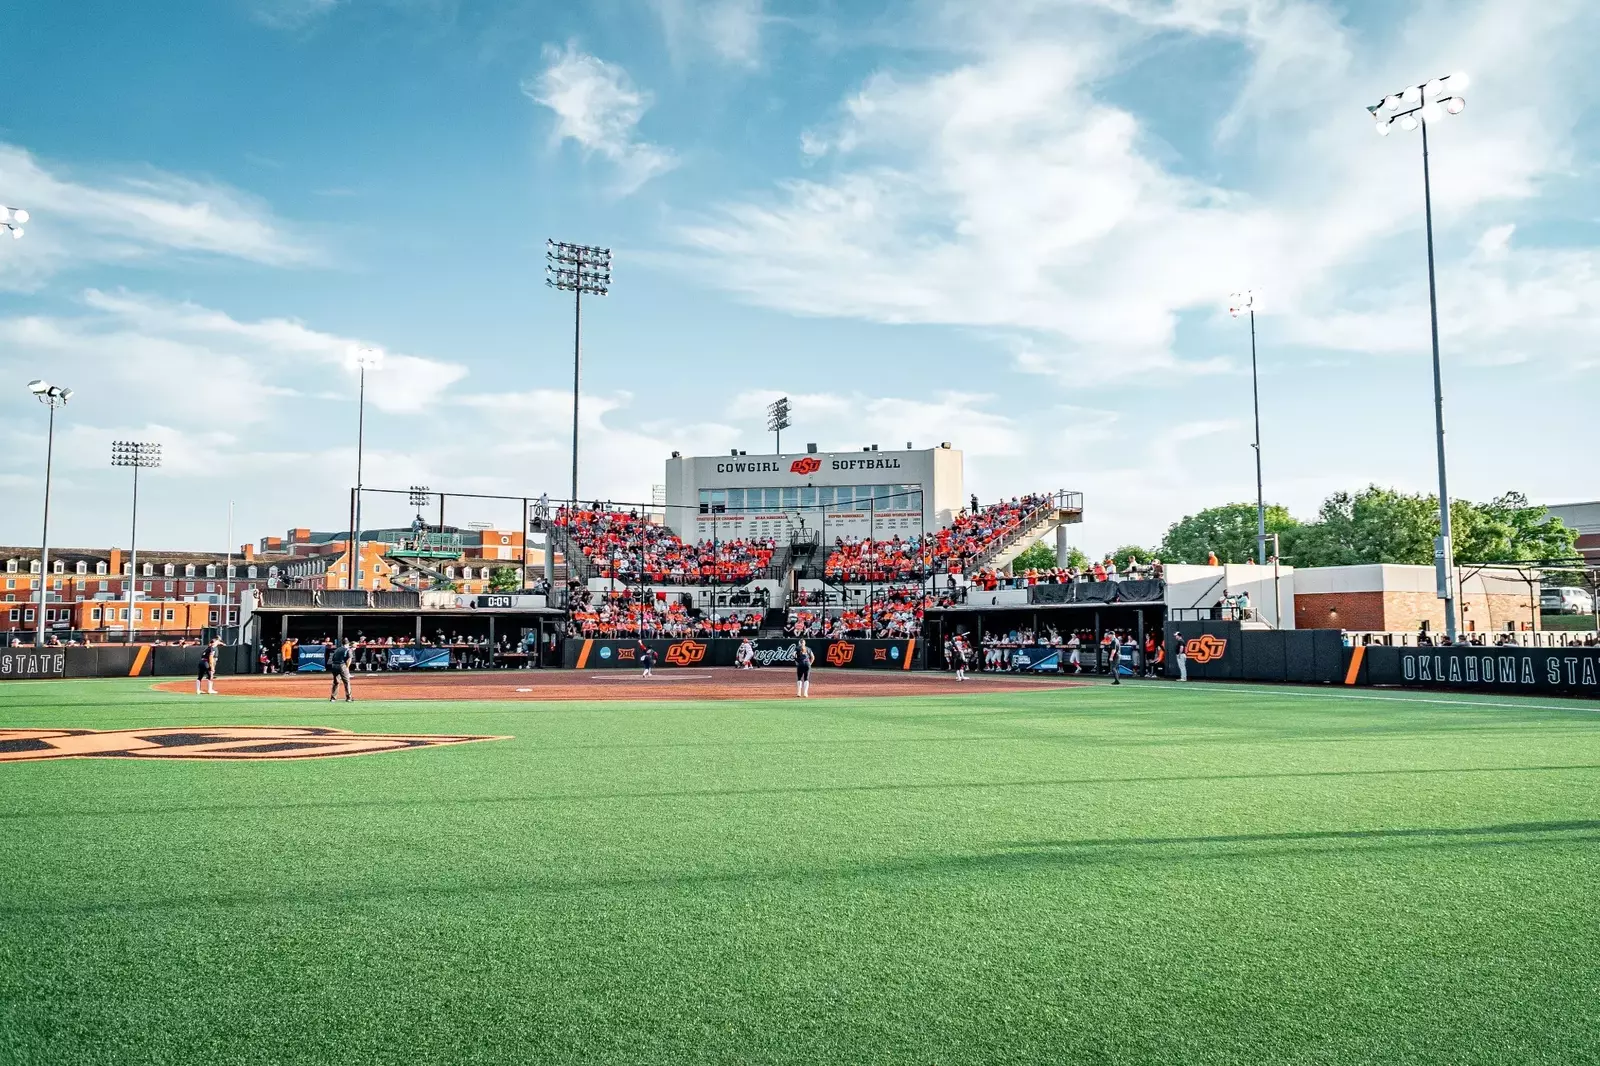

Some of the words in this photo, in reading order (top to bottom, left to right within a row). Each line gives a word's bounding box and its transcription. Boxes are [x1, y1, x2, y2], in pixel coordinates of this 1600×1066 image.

[717, 462, 779, 473] COWGIRL
[789, 457, 822, 475] OSU
[832, 458, 900, 470] SOFTBALL
[488, 597, 509, 606] 0:09
[665, 640, 707, 666] OSU
[826, 640, 855, 666] OSU
[1185, 634, 1227, 664] OSU
[2, 654, 63, 674] STATE
[1404, 655, 1535, 684] OKLAHOMA
[1546, 656, 1600, 684] STA
